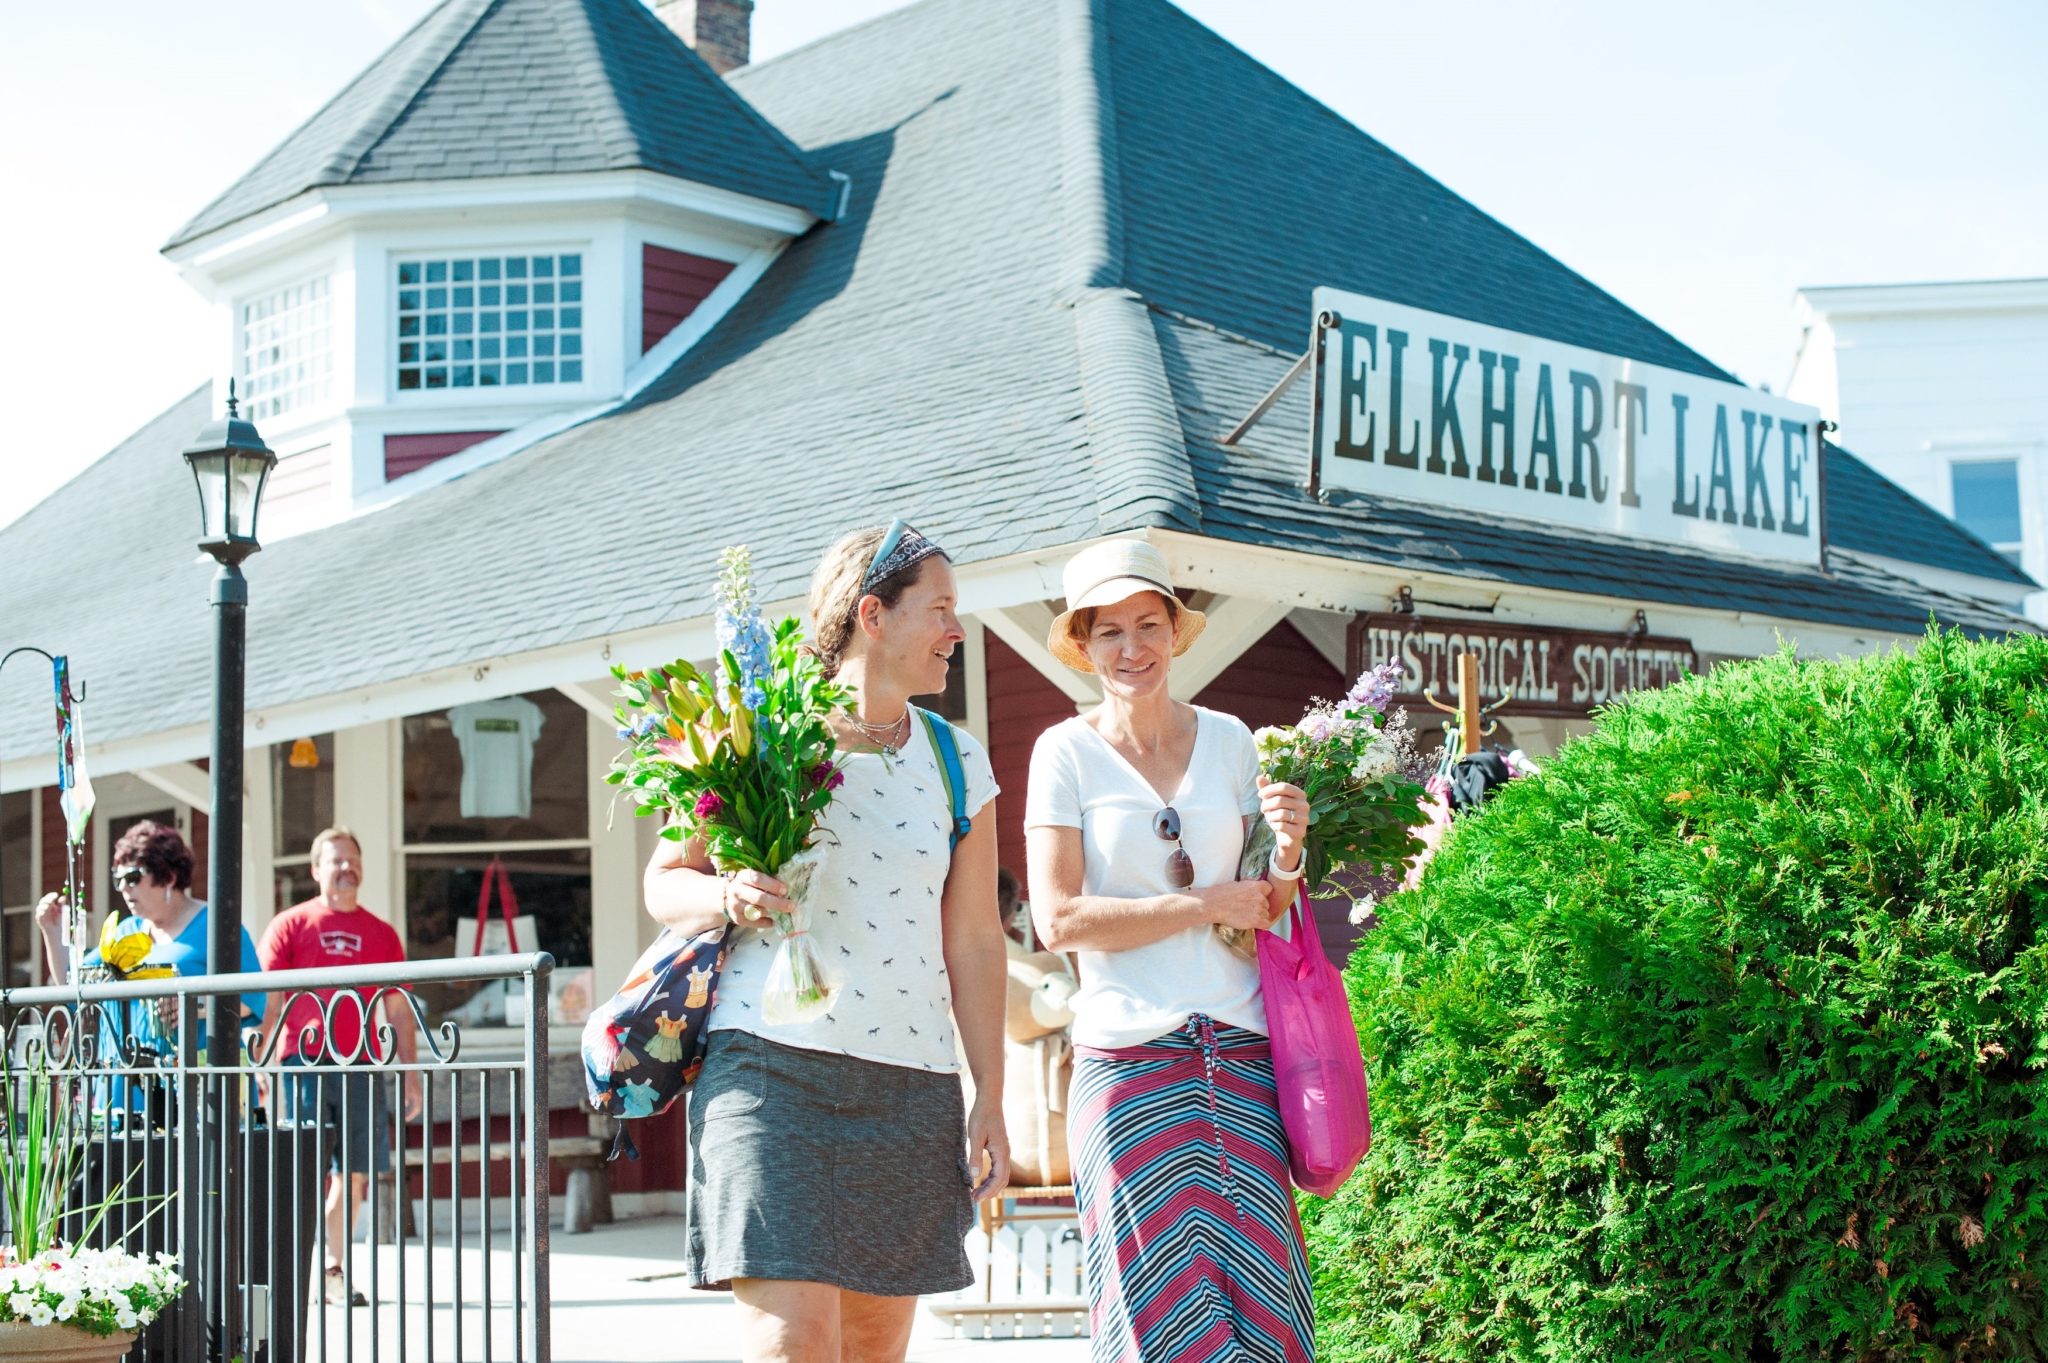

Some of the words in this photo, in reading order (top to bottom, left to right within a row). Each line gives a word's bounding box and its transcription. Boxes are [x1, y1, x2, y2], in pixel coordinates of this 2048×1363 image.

[1335, 318, 1648, 508] ELKHART
[1671, 393, 1810, 537] LAKE
[1368, 627, 1559, 702] HISTORICAL
